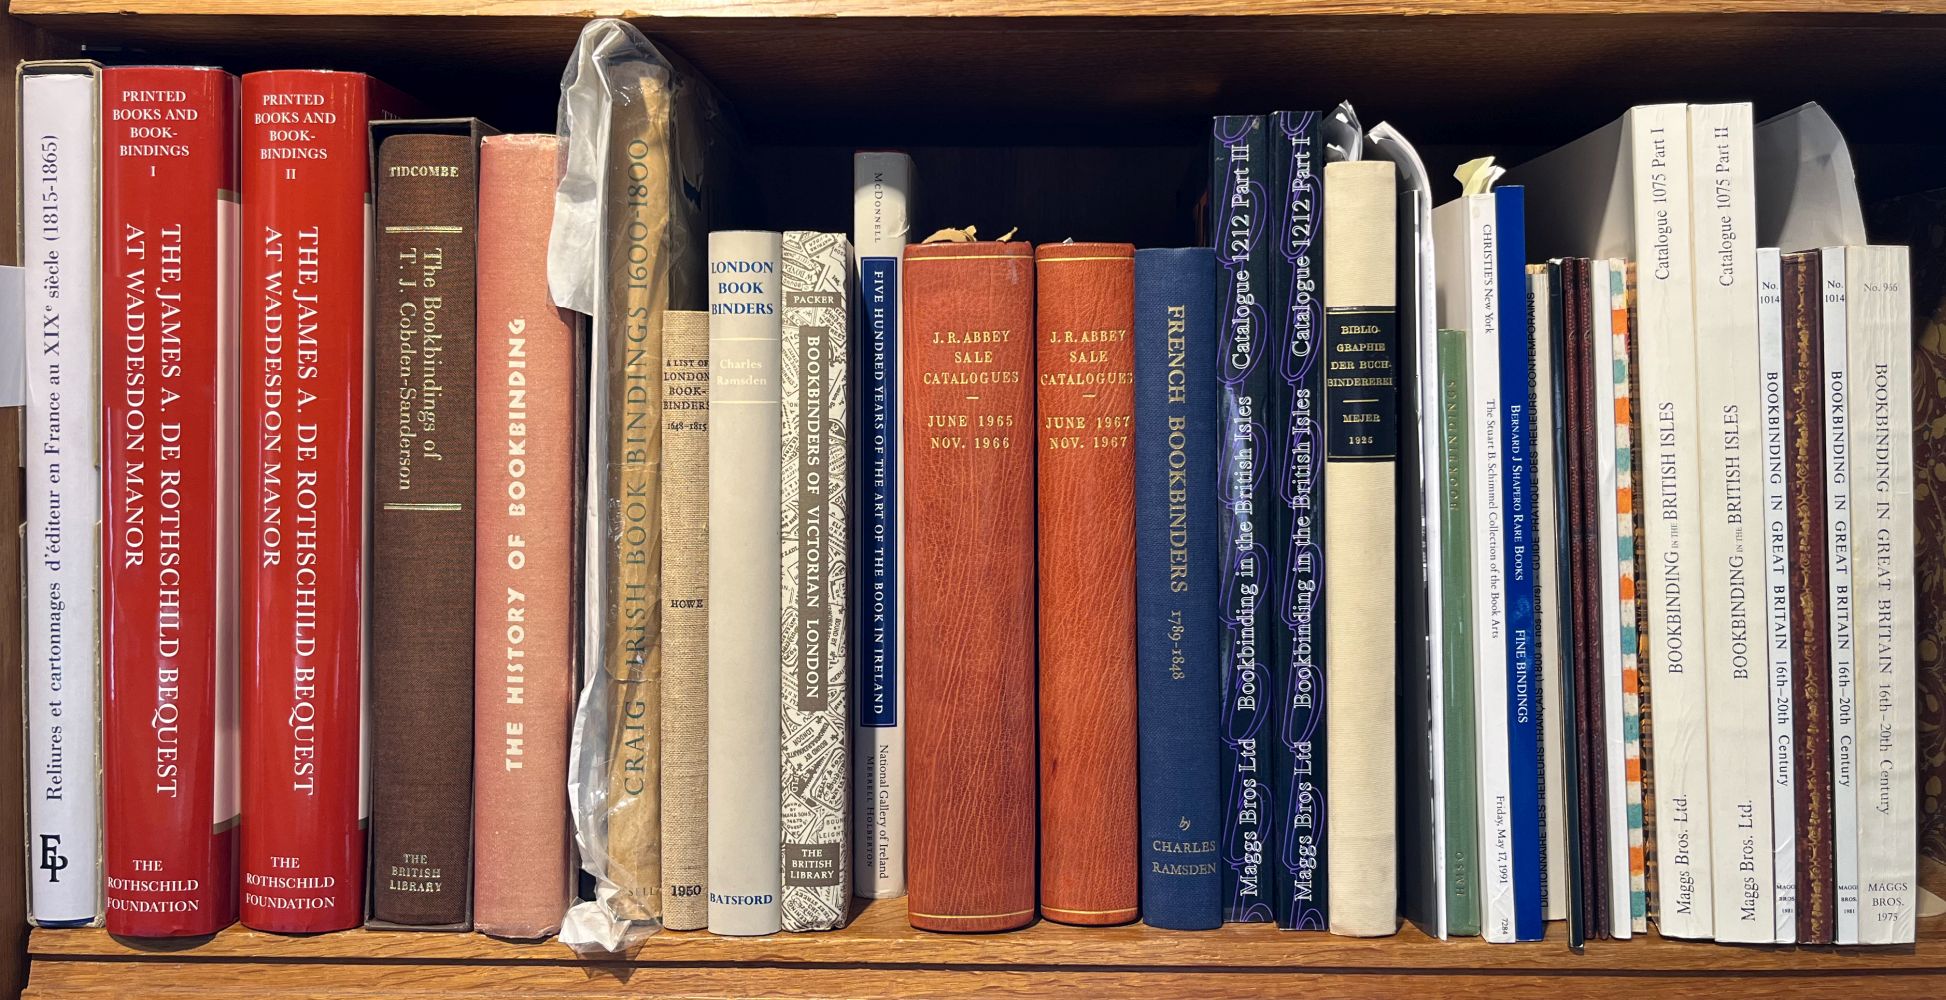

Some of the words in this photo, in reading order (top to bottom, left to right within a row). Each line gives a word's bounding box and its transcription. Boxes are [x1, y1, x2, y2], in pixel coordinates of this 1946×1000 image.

[123, 91, 186, 101] PRINTED
[166, 109, 197, 120] AND
[131, 127, 177, 138] BOOK-
[120, 145, 189, 156] BINDINGS
[1232, 144, 1249, 162] II
[1652, 140, 1665, 167] Part
[152, 166, 155, 176] I
[391, 166, 458, 177] TIDCOMBE
[42, 136, 59, 240] (1815-1865)
[1232, 168, 1249, 208] Part
[1652, 174, 1666, 202] 1075
[127, 224, 144, 259] AT
[1231, 215, 1249, 261] 1212
[1654, 211, 1672, 280] Catalogue
[162, 224, 180, 282] THE
[400, 248, 416, 269] T.
[1483, 225, 1492, 285] CHRISTIE'S
[44, 251, 58, 298] siècle
[424, 248, 442, 287] The
[712, 262, 774, 274] LONDON
[399, 279, 416, 292] J.
[719, 280, 763, 293] BOOK
[875, 271, 883, 302] FIVE
[1485, 289, 1493, 309] New
[1864, 283, 1880, 291] No.
[712, 303, 773, 314] BINDERS
[1232, 270, 1254, 369] Catalogue
[156, 287, 180, 377] JAMES
[1341, 326, 1380, 334] BIBLIO-
[1485, 313, 1494, 333] York
[874, 309, 883, 380] HUNDRED
[955, 351, 992, 363] SALE
[1168, 305, 1185, 403] FRENCH
[1337, 343, 1385, 352] GRAPHIE
[127, 269, 144, 451] WADDESDON
[418, 296, 442, 431] Bookbindings
[720, 359, 761, 369] Charles
[1359, 361, 1391, 369] BUCH-
[50, 365, 59, 385] au
[626, 306, 648, 466] BINDINGS
[664, 370, 709, 381] LONDON
[717, 375, 765, 385] Ramsden
[924, 372, 1018, 384] CATALOGUES
[161, 387, 180, 411] A.
[400, 302, 417, 489] Cobden-Sanderson
[808, 336, 820, 465] BOOKBINDERS
[875, 386, 883, 429] YEARS
[1487, 399, 1496, 417] The
[44, 397, 60, 453] France
[508, 319, 526, 515] BOOKBINDING
[928, 415, 967, 427] JUNE
[979, 415, 1012, 426] 1965
[1233, 397, 1251, 442] Isles
[1343, 414, 1380, 422] MEJER
[1659, 403, 1674, 446] ISLES
[162, 423, 180, 460] DE
[875, 436, 883, 453] OF
[931, 437, 965, 449] NOV.
[975, 437, 1009, 448] 1966
[1487, 421, 1495, 448] Stuart
[424, 440, 442, 460] of
[1488, 453, 1496, 462] B.
[50, 464, 60, 483] en
[808, 472, 819, 494] OF
[875, 459, 883, 486] THE
[1233, 448, 1252, 515] British
[1488, 464, 1498, 508] Schimmel
[1661, 454, 1677, 520] BRITISH
[126, 462, 143, 568] MANOR
[875, 493, 883, 519] ART
[1169, 416, 1187, 592] BOOKBINDERS
[626, 481, 646, 565] BOOK
[875, 525, 883, 542] OF
[1234, 521, 1253, 552] the
[1489, 512, 1498, 560] Collection
[160, 470, 180, 657] ROTHSCHILD
[508, 535, 525, 569] OF
[807, 506, 819, 607] VICTORIAN
[875, 548, 883, 576] THE
[1235, 558, 1253, 577] in
[1490, 563, 1500, 573] of
[1491, 575, 1500, 589] the
[671, 599, 703, 608] HOWE
[875, 583, 883, 621] BOOK
[1491, 593, 1500, 616] Book
[1664, 552, 1683, 673] BOOKBINDING
[49, 583, 65, 691] cartonnages
[625, 584, 647, 667] IRISH
[875, 628, 883, 642] IN
[1492, 620, 1500, 638] Arts
[507, 588, 525, 704] HISTORY
[1236, 584, 1258, 710] Bookbinding
[1516, 630, 1525, 658] FINE
[807, 619, 819, 698] LONDON
[875, 649, 883, 713] IRELAND
[1517, 662, 1528, 723] BINDINGS
[49, 702, 61, 716] et
[152, 667, 178, 797] BEQUEST
[506, 722, 523, 771] THE
[623, 699, 645, 797] CRAIG
[1238, 738, 1256, 772] Ltd
[47, 726, 62, 800] Reliures
[880, 745, 889, 787] National
[877, 790, 889, 827] Gallery
[1239, 779, 1256, 824] Bros
[1673, 792, 1687, 822] Ltd.
[880, 830, 889, 841] of
[1179, 817, 1191, 831] by
[1153, 840, 1215, 853] CHARLES
[1498, 830, 1506, 848] May
[1675, 827, 1689, 865] Bros.
[133, 860, 162, 871] THE
[792, 860, 832, 868] BRITISH
[802, 849, 822, 857] THE
[880, 844, 888, 878] Ireland
[1240, 831, 1262, 896] Maggs
[791, 871, 834, 879] LIBRARY
[1152, 862, 1215, 875] RAMSDEN
[1499, 865, 1508, 883] 1991
[108, 877, 198, 891] ROTHSCHILD
[671, 885, 701, 897] 1950
[1677, 872, 1694, 914] Maggs
[1868, 883, 1907, 891] MAGGS
[107, 897, 199, 912] FOUNDATION
[711, 893, 772, 905] BATSFORD
[1872, 898, 1904, 906] BROS.
[1878, 913, 1897, 921] 1975
